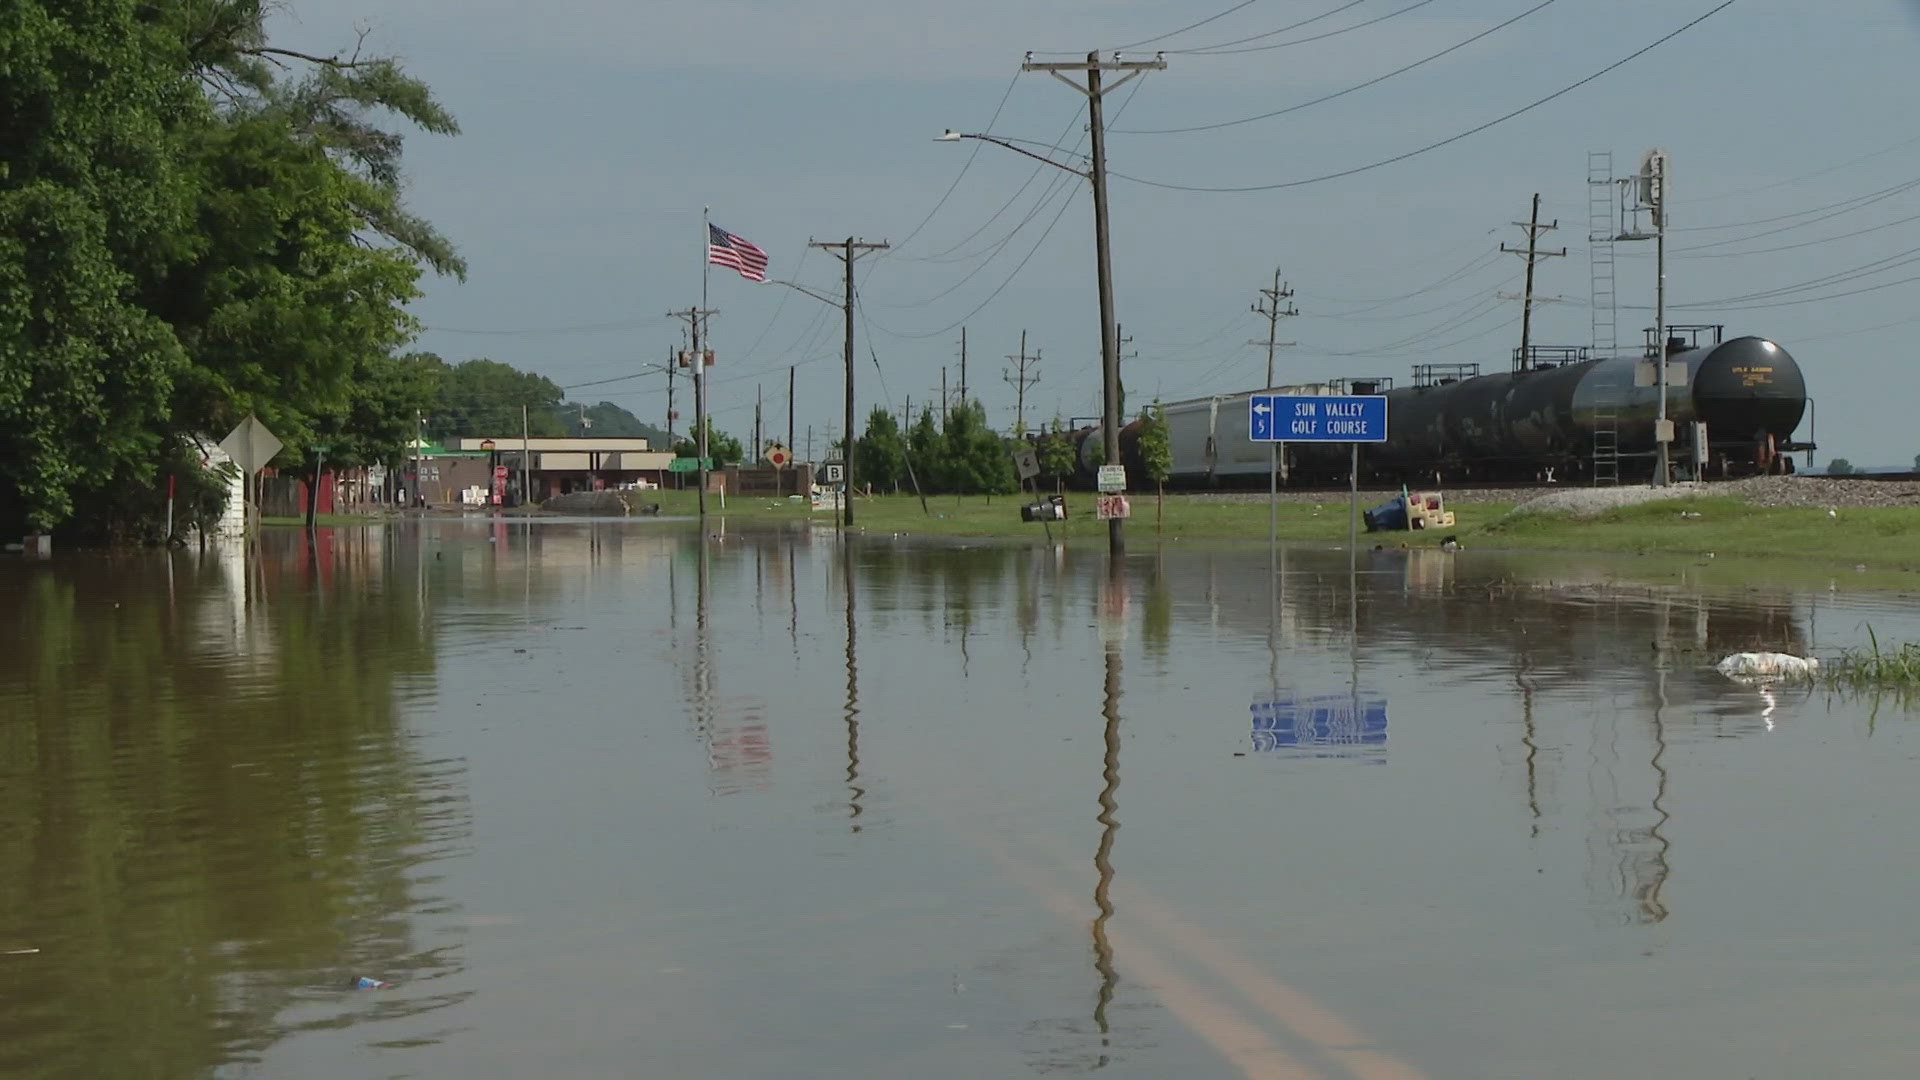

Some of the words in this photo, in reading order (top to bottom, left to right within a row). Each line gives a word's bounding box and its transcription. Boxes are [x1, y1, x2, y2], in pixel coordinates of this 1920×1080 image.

[1295, 403, 1316, 416] SUN
[1326, 403, 1364, 416] VALLEY
[1291, 420, 1317, 434] GOLF
[1327, 420, 1368, 434] COURSE
[831, 467, 839, 478] B
